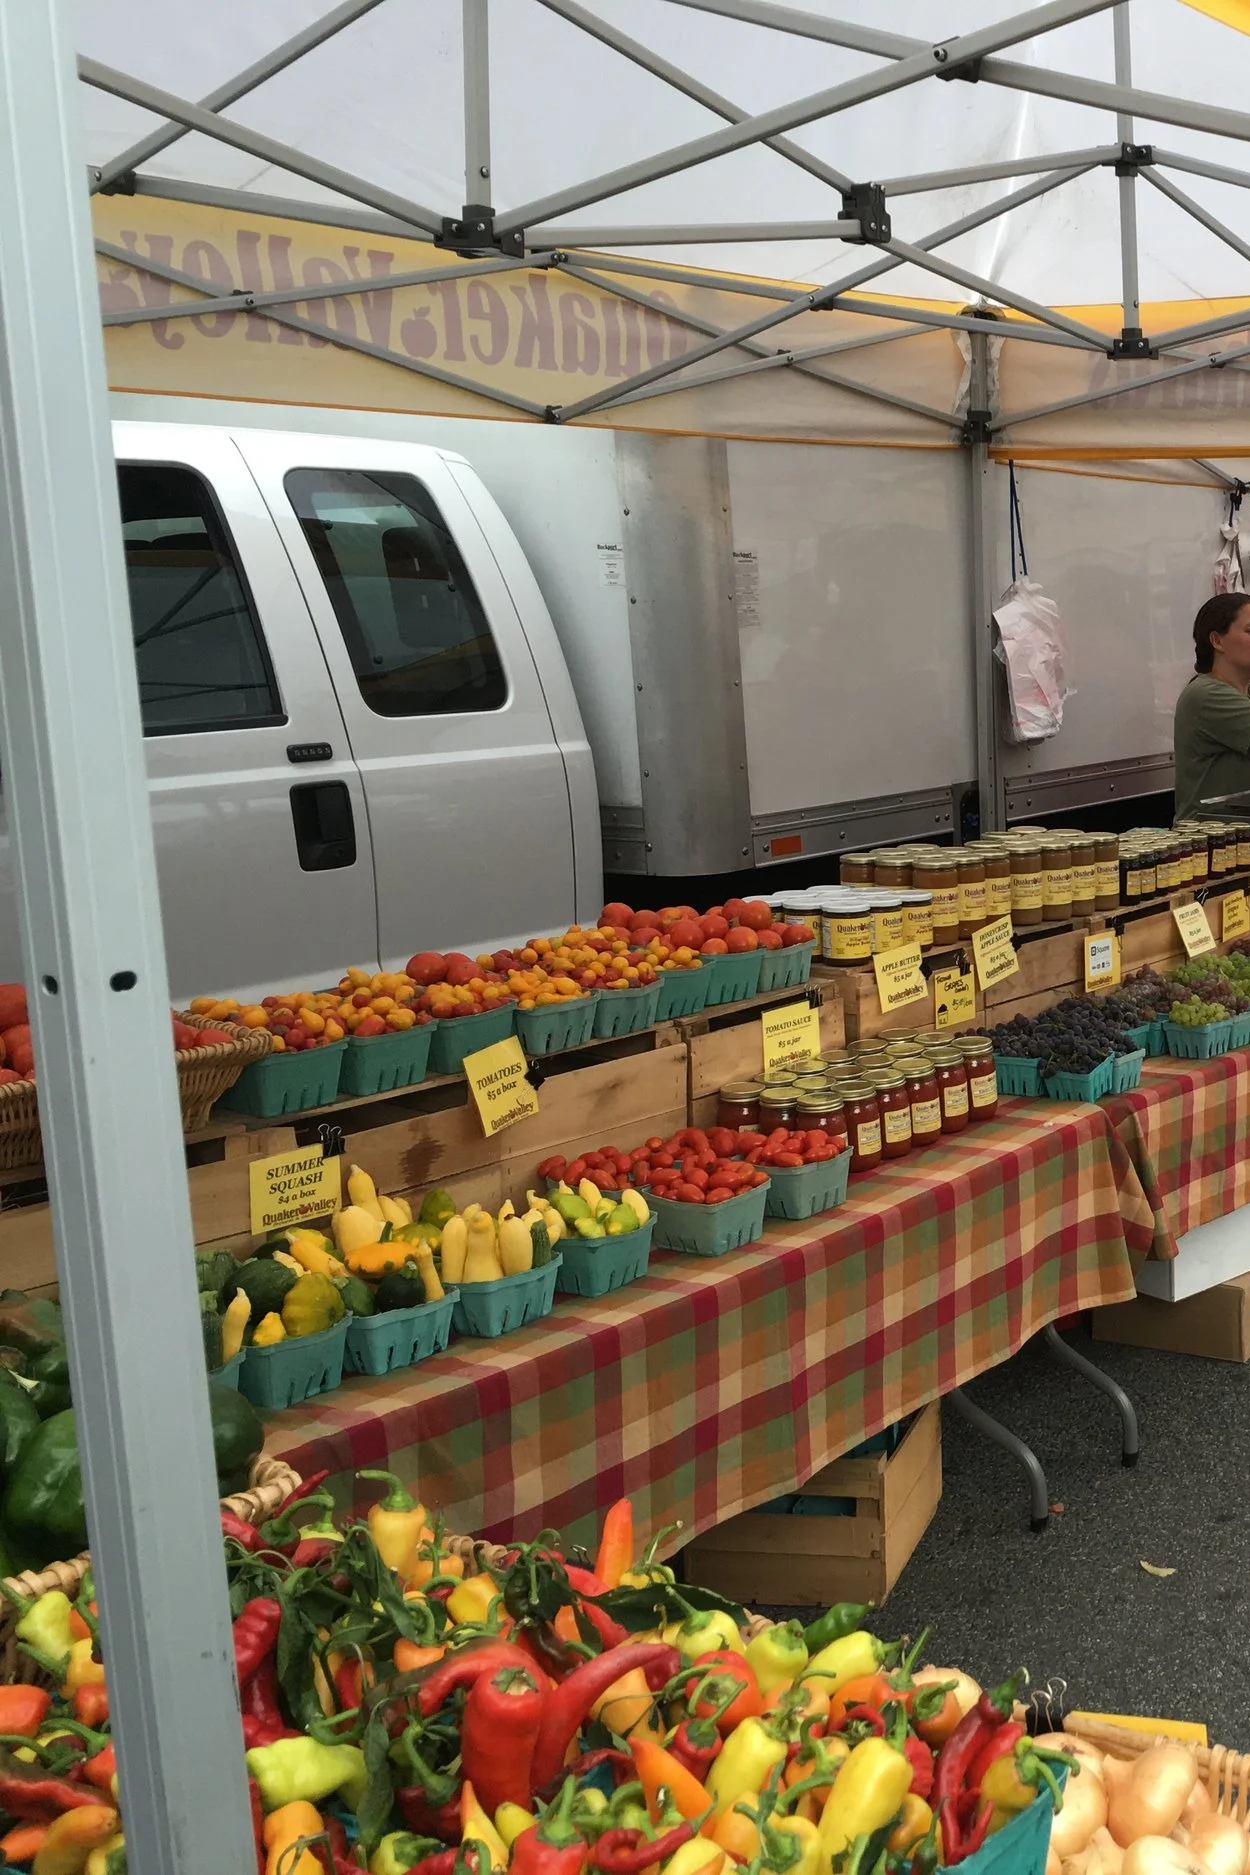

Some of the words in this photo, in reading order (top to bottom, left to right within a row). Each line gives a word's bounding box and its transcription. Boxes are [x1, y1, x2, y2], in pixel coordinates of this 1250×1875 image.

[837, 924, 860, 933] Quaker
[881, 961, 898, 973] APPLE
[900, 955, 920, 967] BUTTER
[765, 1021, 791, 1034] TOMATO
[792, 1015, 812, 1027] SAUCE
[476, 1062, 522, 1090] TOMATOES
[487, 1090, 496, 1101] $5
[501, 1080, 517, 1093] box
[490, 1110, 511, 1130] Quaker
[266, 1157, 324, 1181] SUMMER
[269, 1171, 323, 1195] SQUASH
[278, 1195, 289, 1204] $4
[300, 1189, 316, 1199] box
[263, 1208, 300, 1227] Quaker
[308, 1197, 337, 1213] Valley
